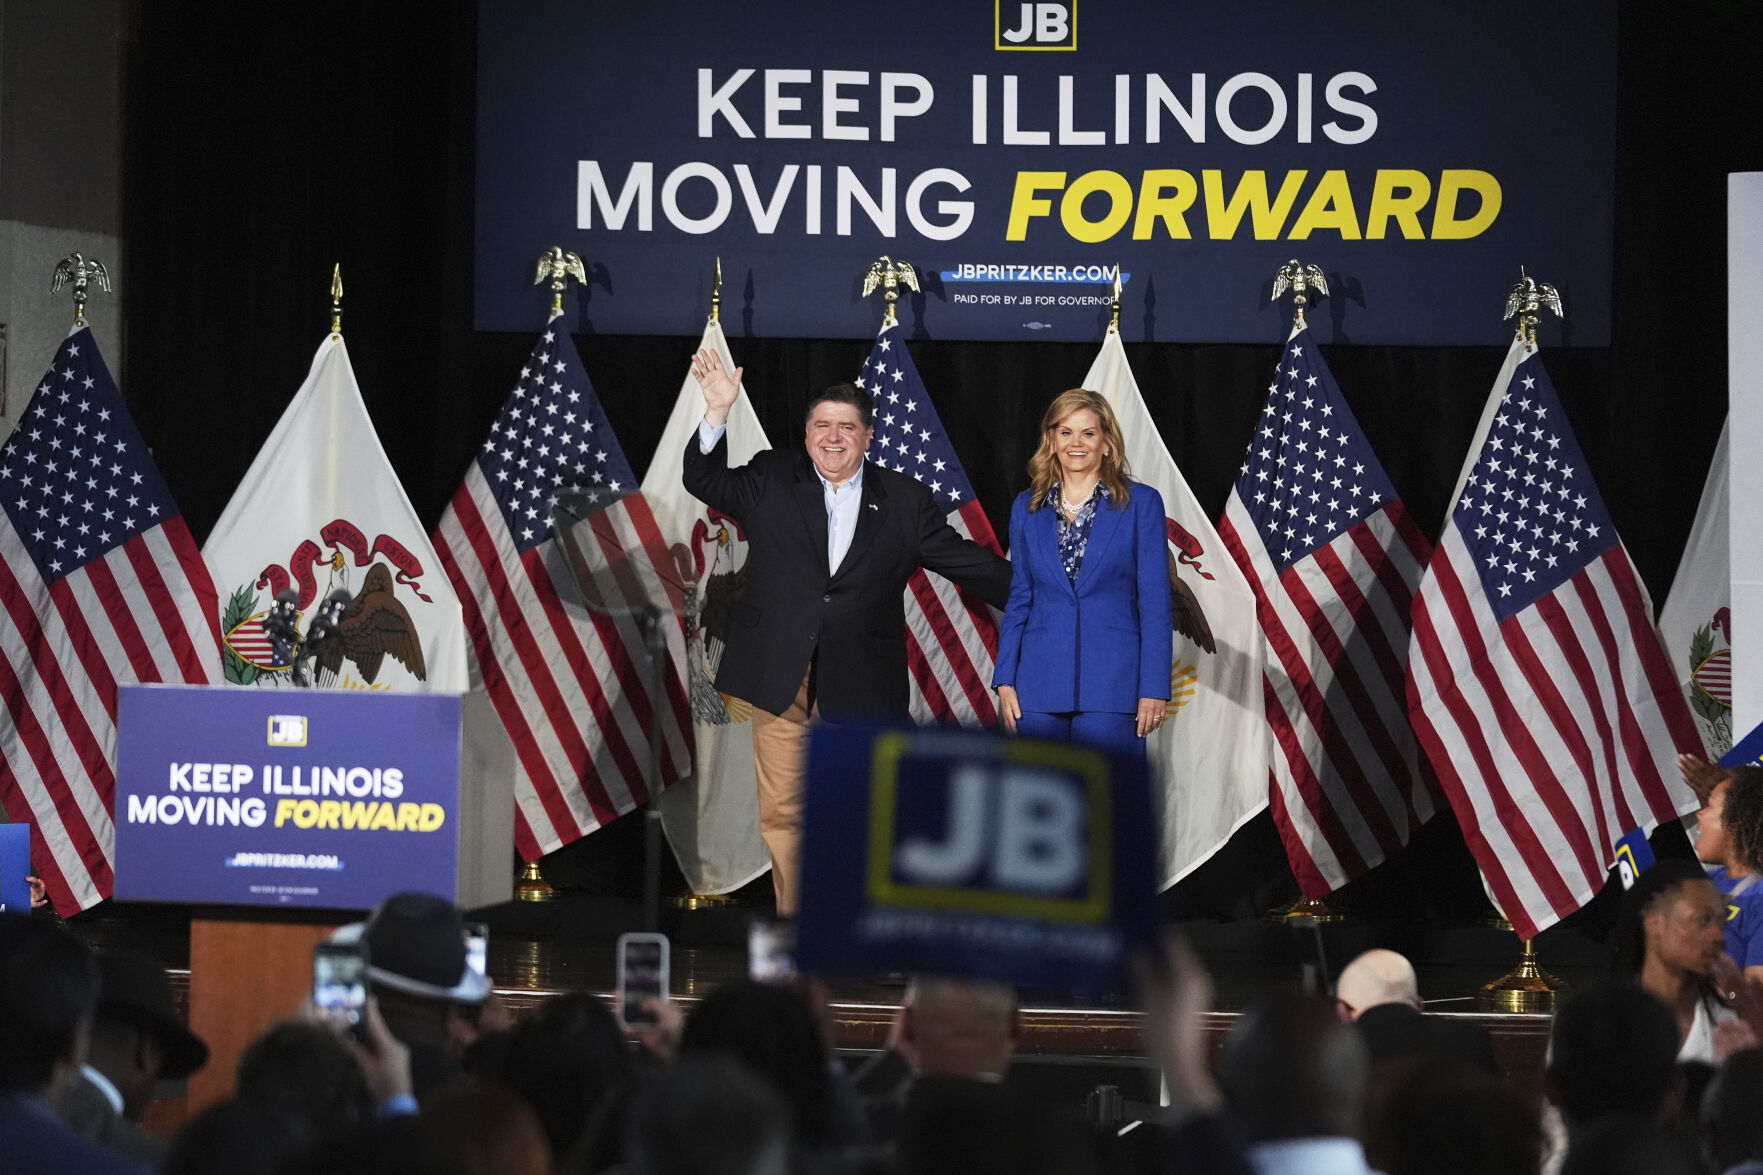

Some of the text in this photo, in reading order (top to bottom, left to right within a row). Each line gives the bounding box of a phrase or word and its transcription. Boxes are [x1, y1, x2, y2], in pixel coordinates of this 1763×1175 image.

[1002, 3, 1069, 43] JB
[697, 68, 1378, 146] KEEP ILLINOIS
[576, 159, 1503, 243] MOVING FORWARD
[951, 263, 1117, 281] JBPRITZKER.COM
[953, 294, 978, 304] PAID
[980, 294, 1001, 305] FOR
[1003, 295, 1018, 305] BY
[1018, 295, 1033, 305] JB
[1034, 295, 1056, 306] FOR
[383, 541, 415, 570] UNION
[169, 762, 404, 798] KEEP ILLINOIS
[127, 794, 446, 832] MOVING FORWARD
[901, 767, 1084, 889] JB
